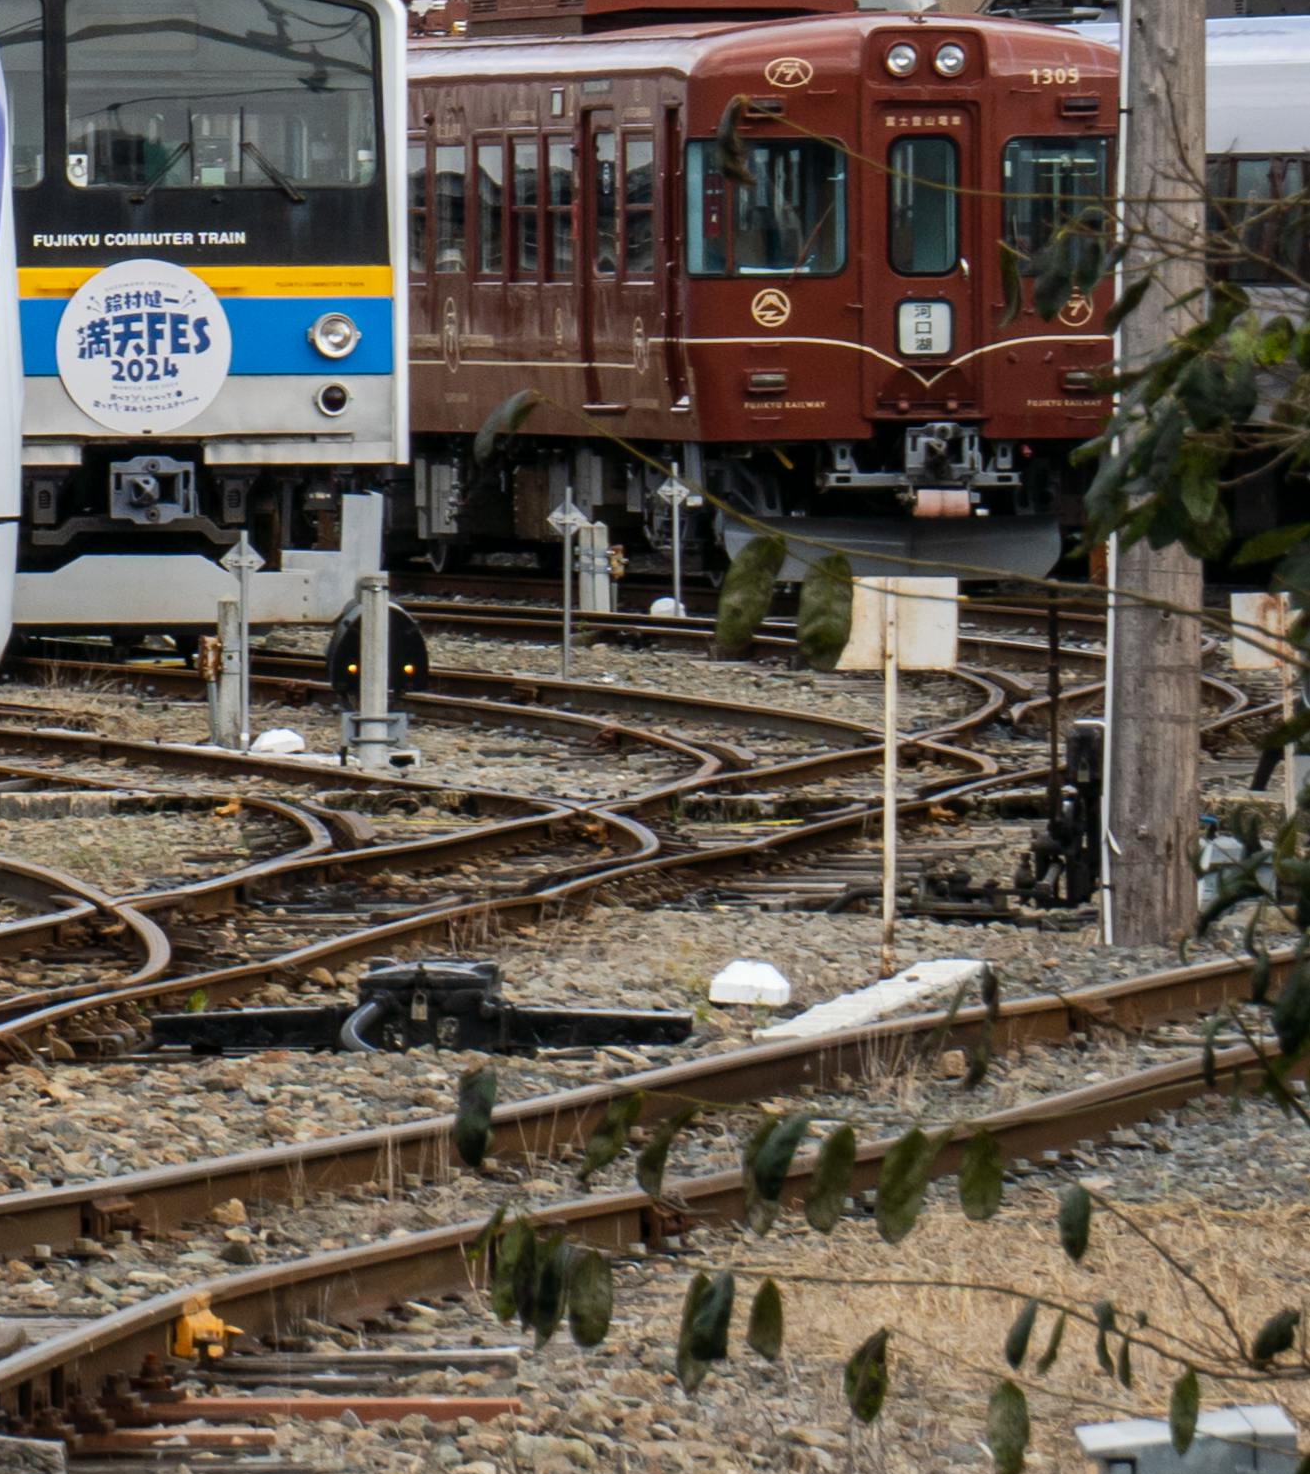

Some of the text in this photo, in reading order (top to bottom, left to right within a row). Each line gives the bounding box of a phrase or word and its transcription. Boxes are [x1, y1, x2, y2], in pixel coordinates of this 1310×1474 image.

[1030, 67, 1079, 84] 1305
[33, 232, 246, 247] FUJIKYU COMMUTER TRAIN
[104, 290, 180, 314] 鈴村健一
[110, 357, 179, 383] 2024
